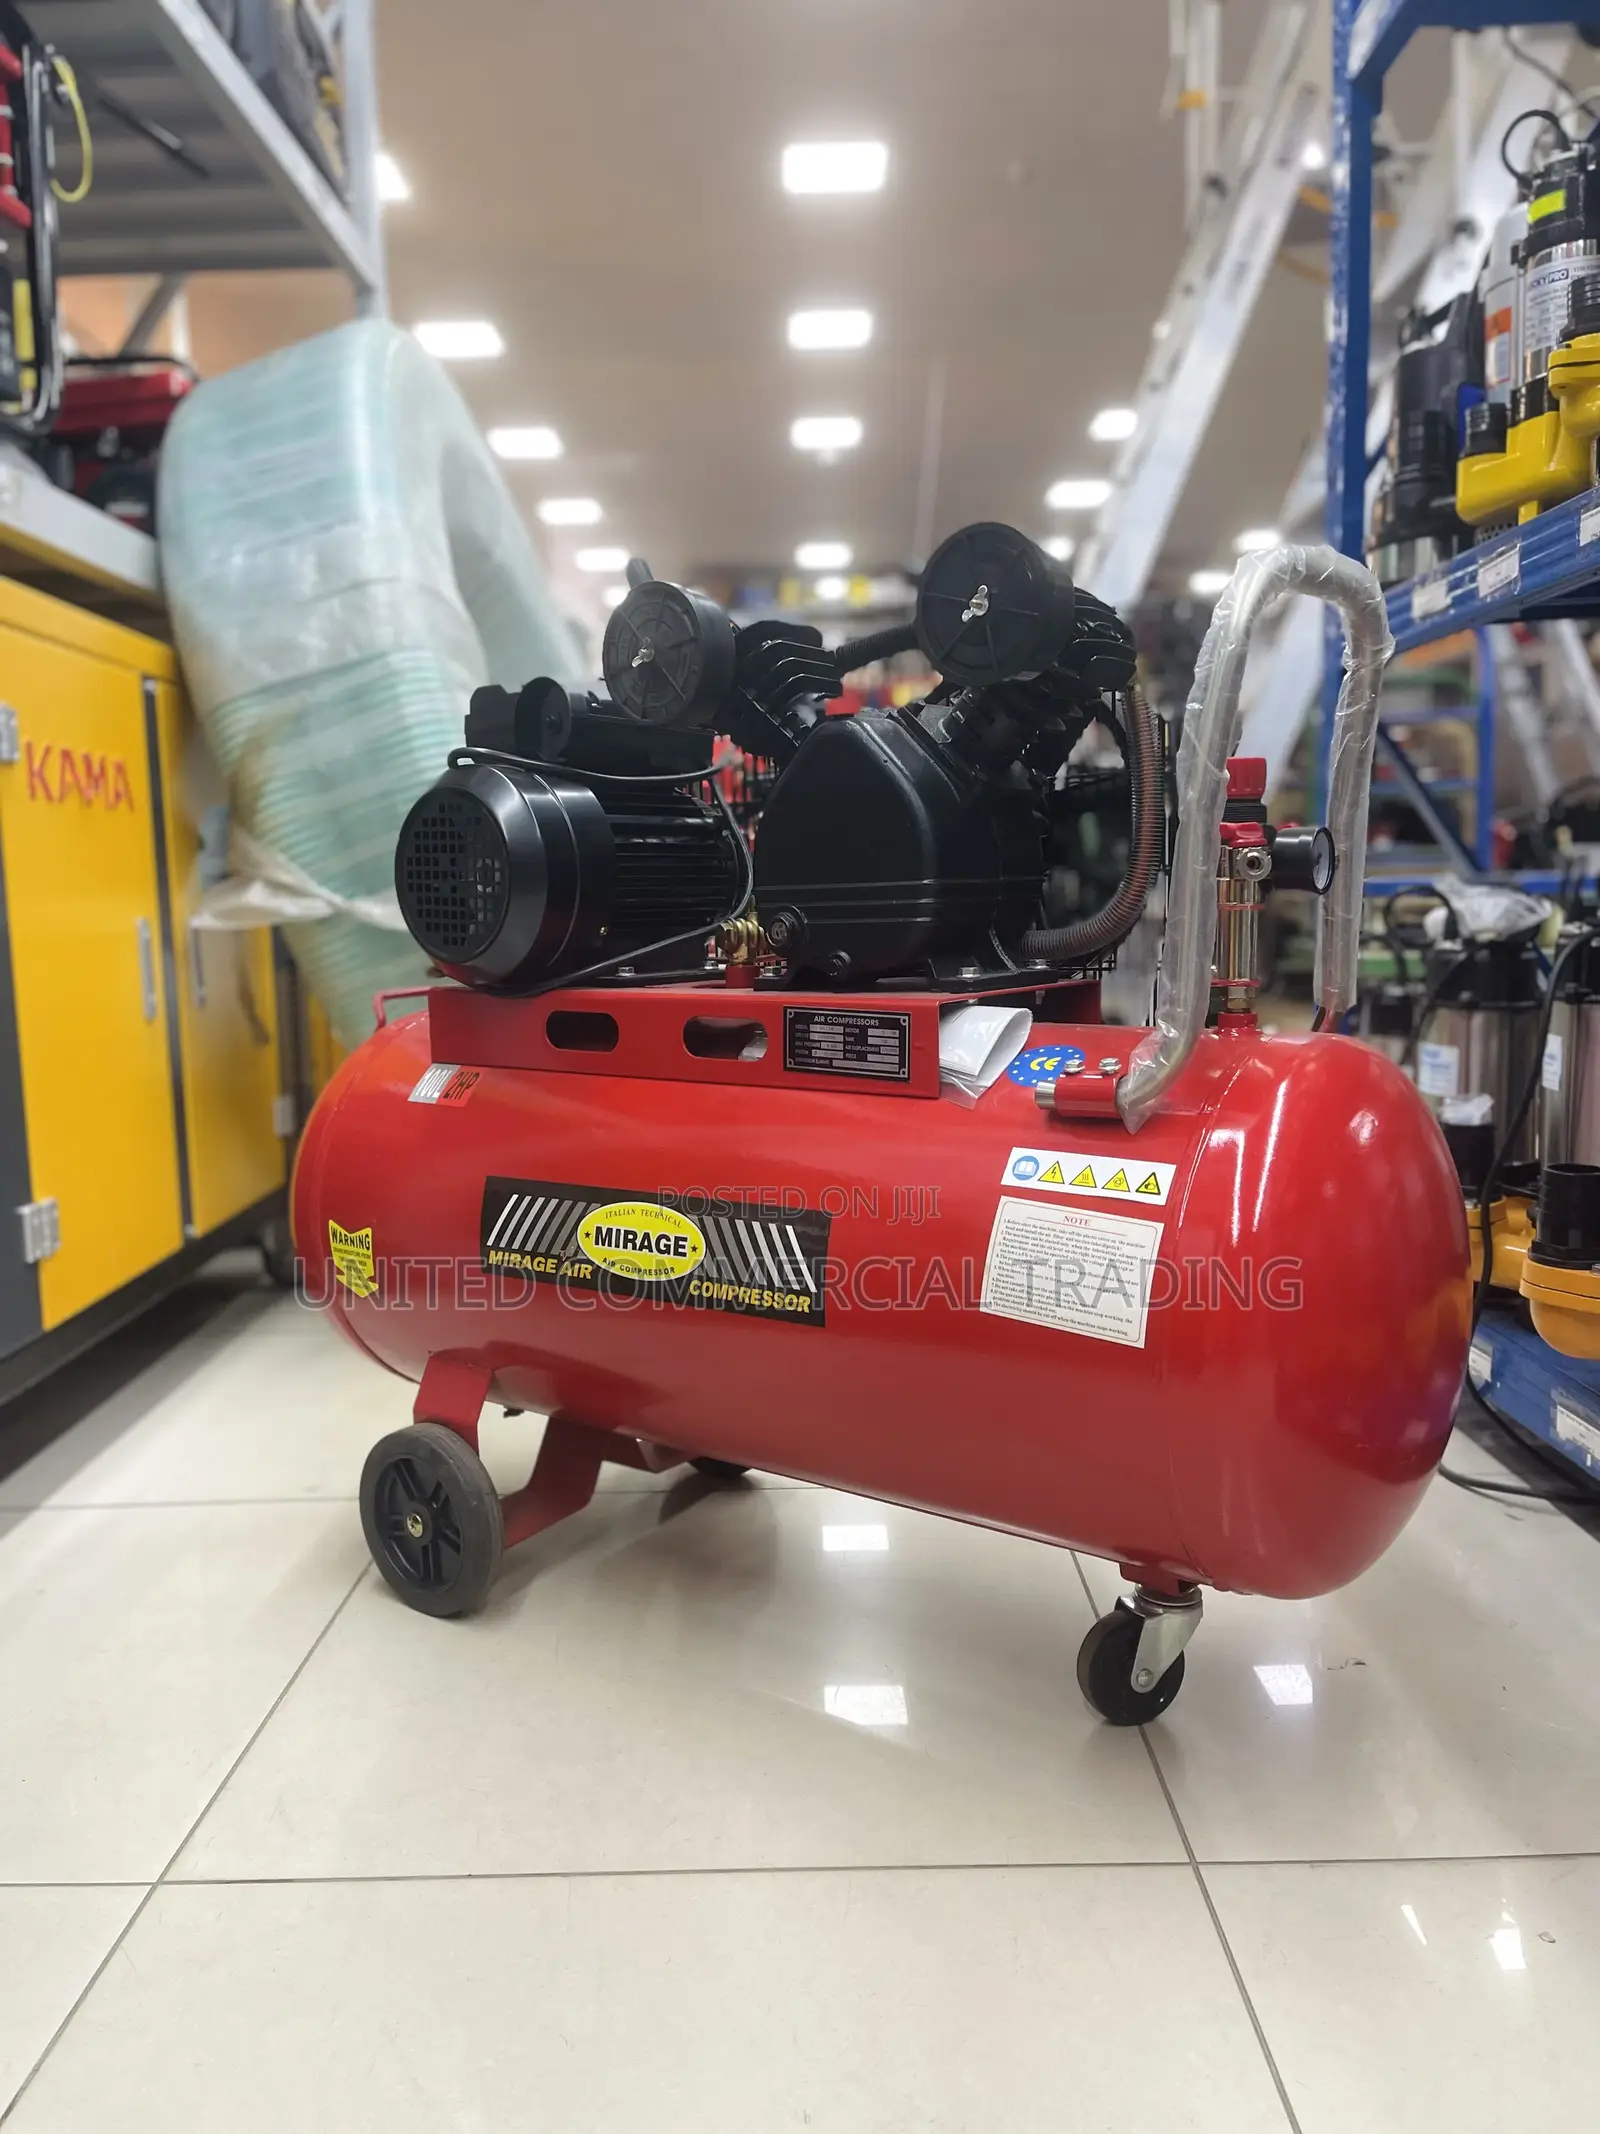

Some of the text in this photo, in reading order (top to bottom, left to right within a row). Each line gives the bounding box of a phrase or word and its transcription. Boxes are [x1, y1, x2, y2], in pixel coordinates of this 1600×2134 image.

[26, 740, 135, 813] KAMA
[827, 1016, 879, 1026] COMPRESSORS
[1030, 1056, 1061, 1071] CE
[443, 1072, 480, 1100] 2HP
[606, 1208, 681, 1228] ITALIAN TECHNICAL
[1063, 1215, 1091, 1227] NOTE
[331, 1226, 370, 1251] WARNING
[594, 1226, 688, 1257] MIRAGE
[603, 1257, 675, 1276] AIR COMPRESSOR
[488, 1250, 810, 1313] MIRAGE AIR COMPRESSOR
